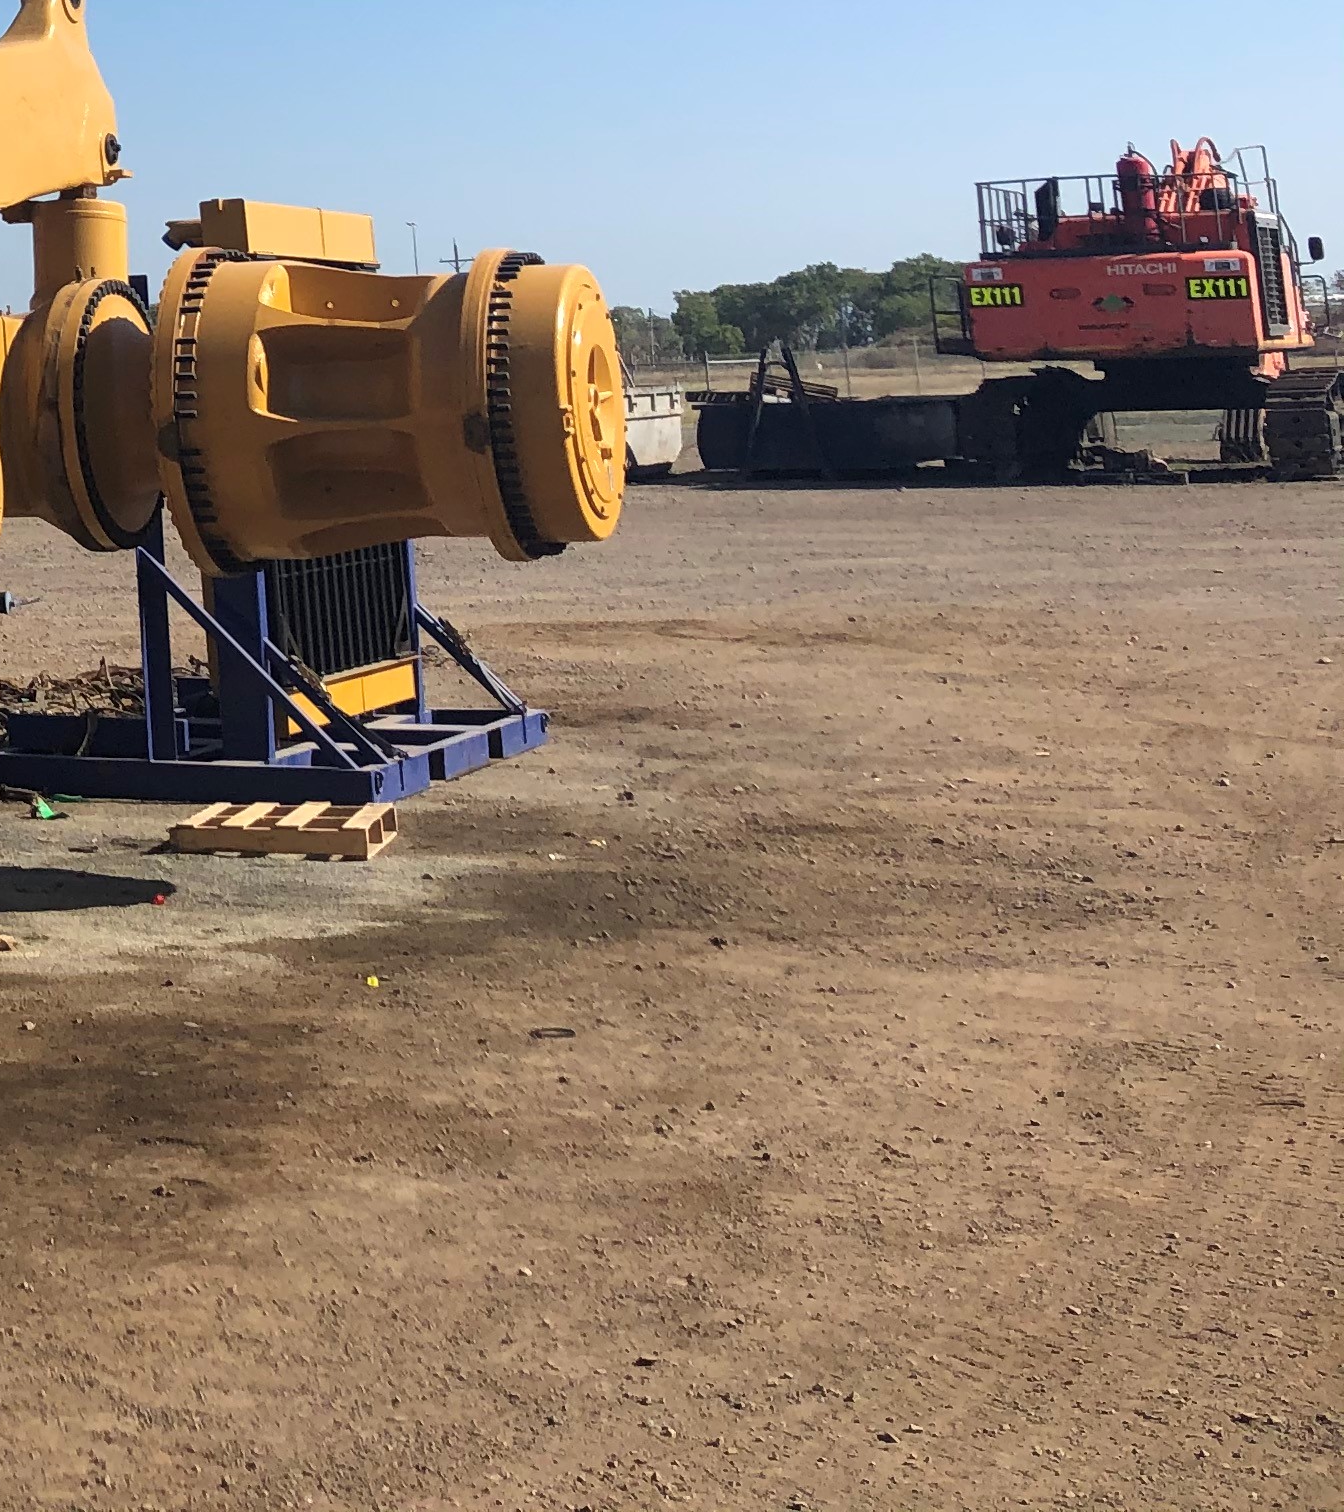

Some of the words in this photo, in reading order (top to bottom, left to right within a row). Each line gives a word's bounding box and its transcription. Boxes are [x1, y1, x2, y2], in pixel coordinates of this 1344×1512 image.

[1107, 263, 1177, 276] HITACHI
[971, 287, 1021, 306] EX111
[1189, 278, 1248, 298] EX111
